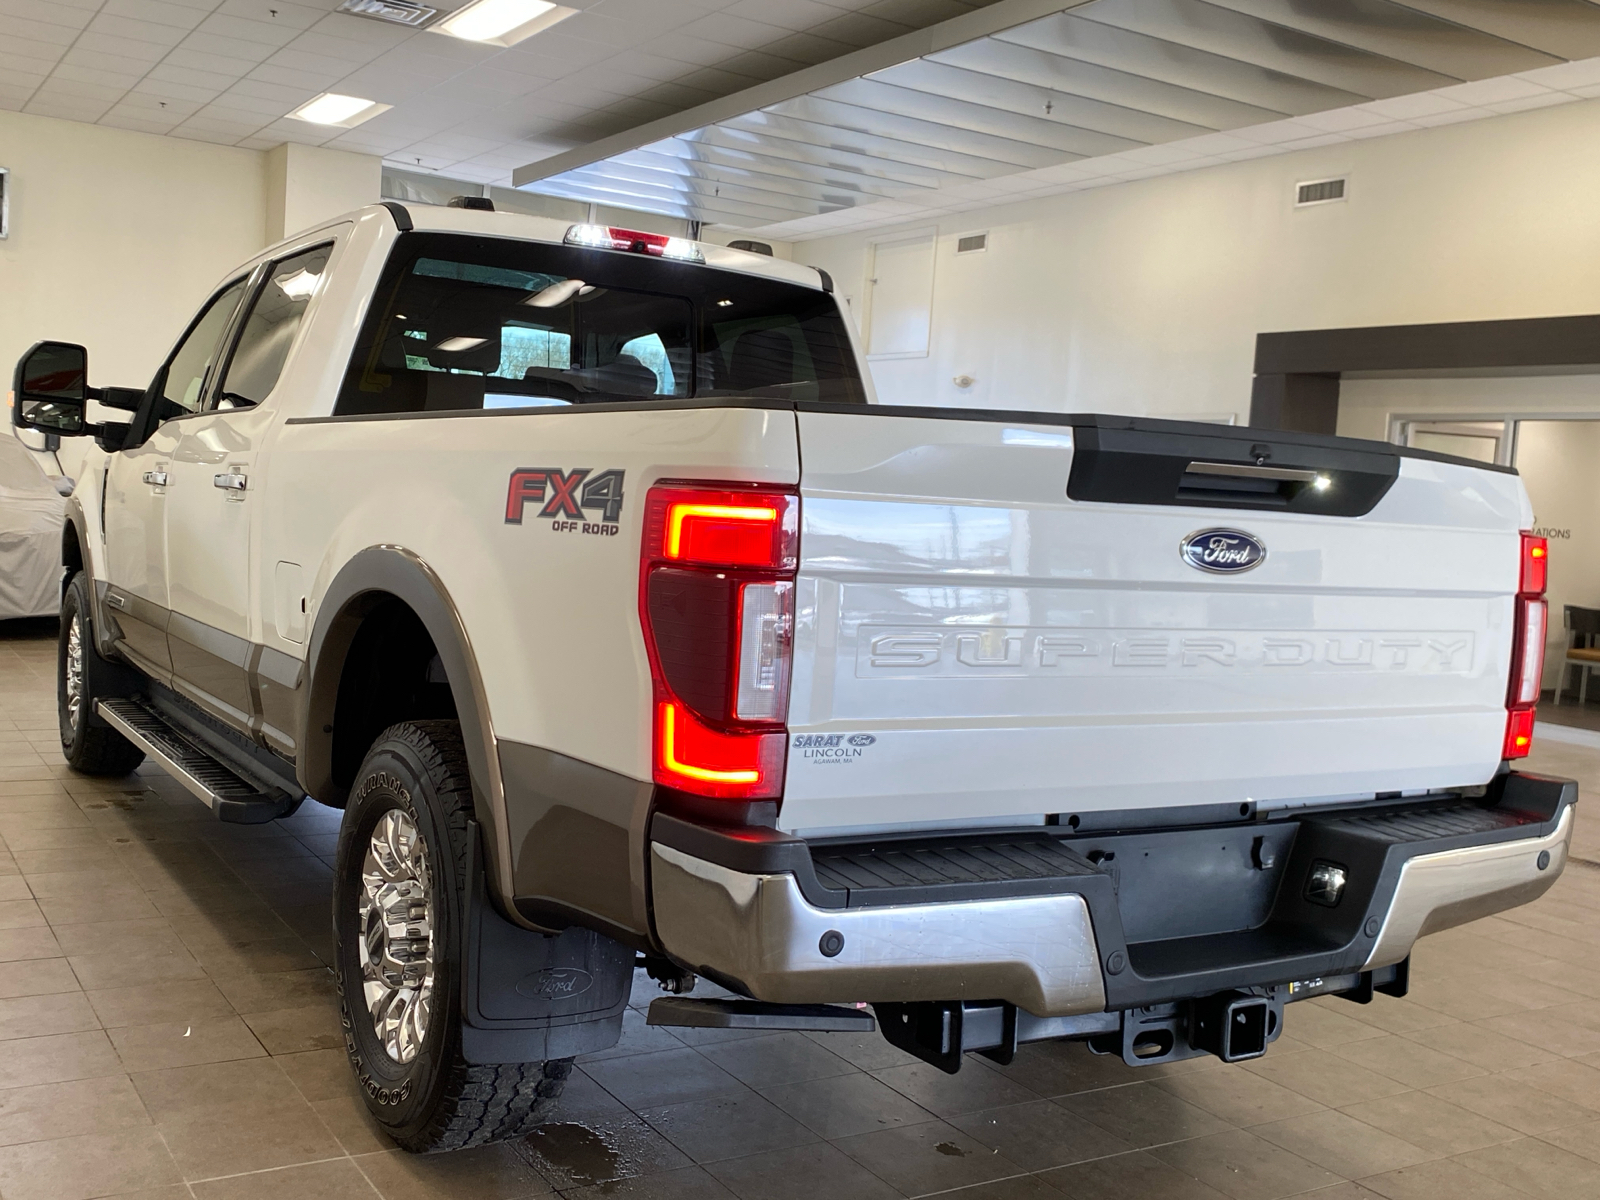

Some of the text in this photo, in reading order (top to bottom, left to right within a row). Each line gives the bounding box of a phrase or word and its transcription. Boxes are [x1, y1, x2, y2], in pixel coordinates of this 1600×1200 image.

[504, 467, 626, 525] FX4
[552, 520, 619, 536] OFF ROAD
[1204, 536, 1251, 564] Ford
[869, 631, 1468, 670] SUPER DUTY
[792, 733, 845, 749] SARAT
[803, 748, 862, 758] LINCOLN
[533, 972, 577, 995] Ford
